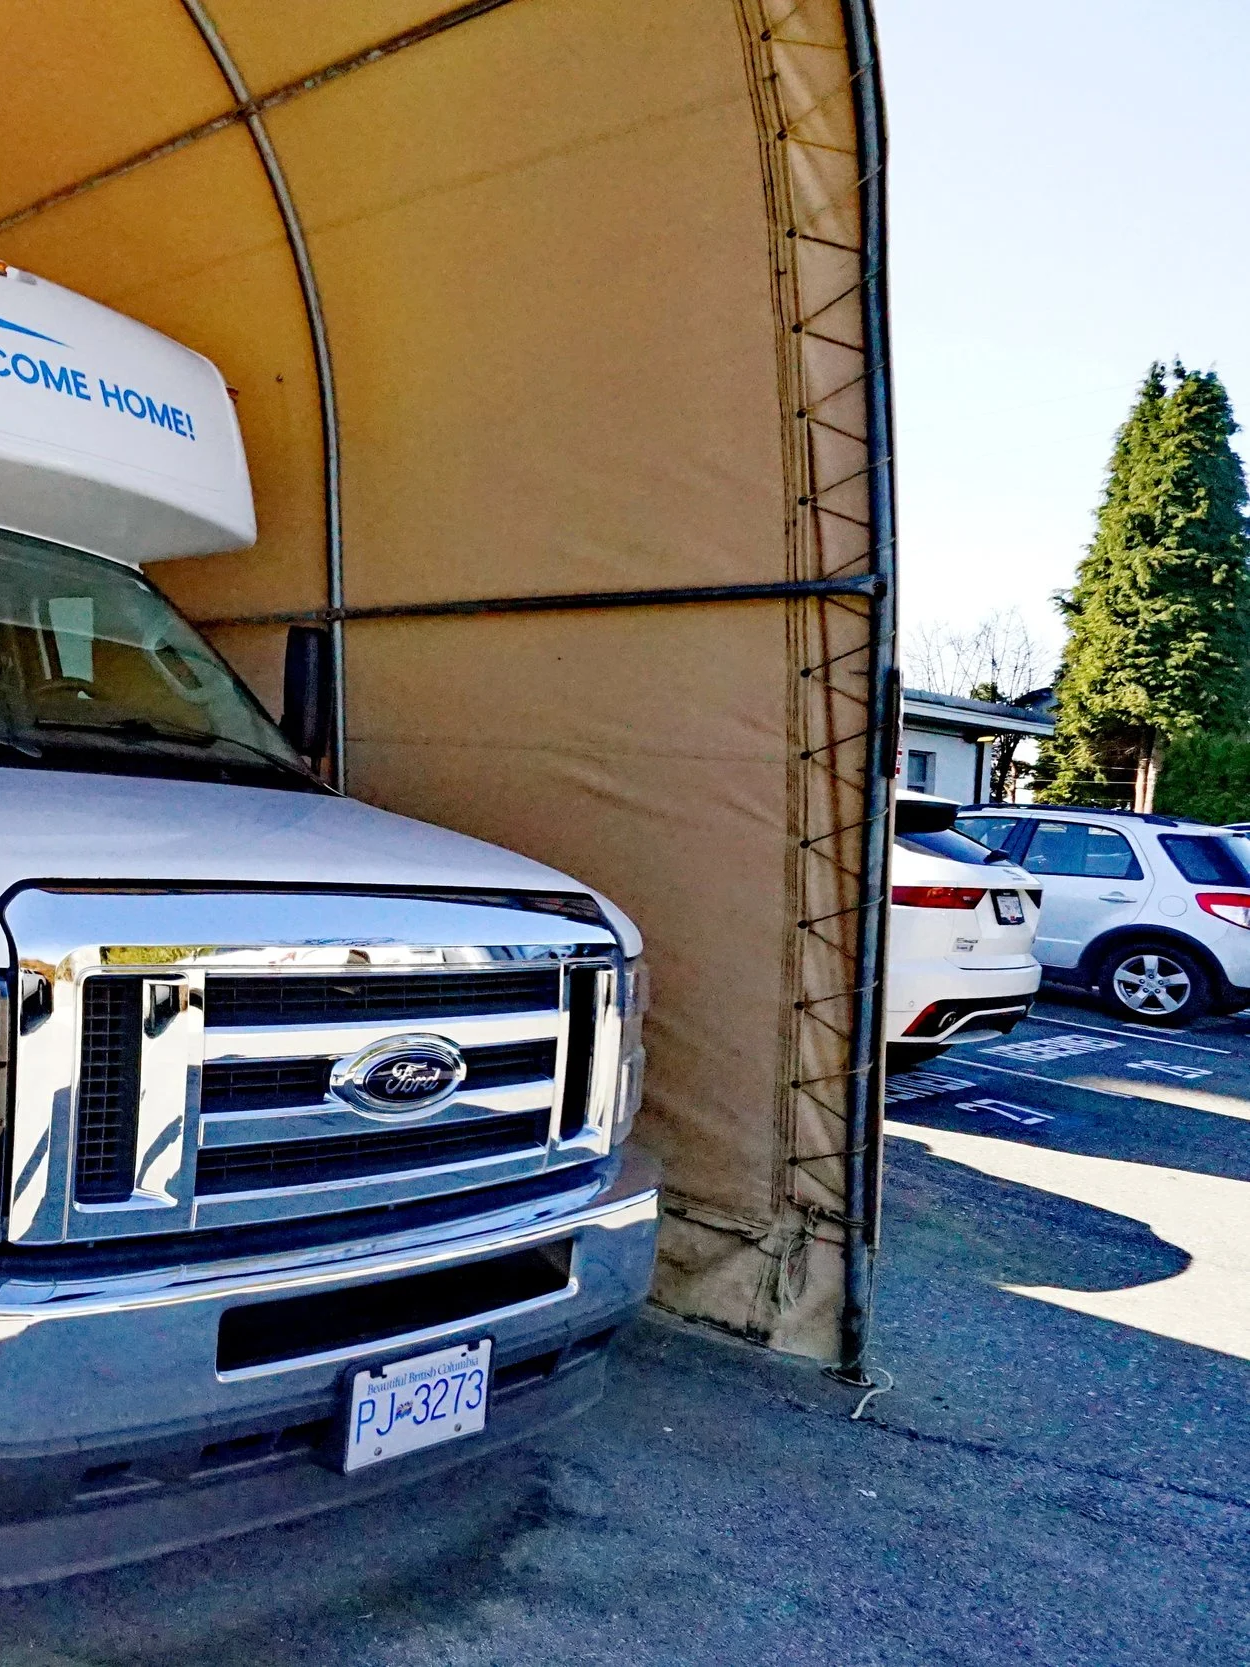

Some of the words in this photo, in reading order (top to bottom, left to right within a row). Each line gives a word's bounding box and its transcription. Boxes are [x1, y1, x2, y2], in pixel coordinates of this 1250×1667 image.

[98, 378, 196, 441] HOME!
[385, 1061, 441, 1095] Ford
[367, 1373, 407, 1396] Beautiful
[408, 1367, 437, 1385] British
[437, 1357, 479, 1376] Columbia
[356, 1392, 396, 1445] PJ
[412, 1368, 484, 1426] 3273
